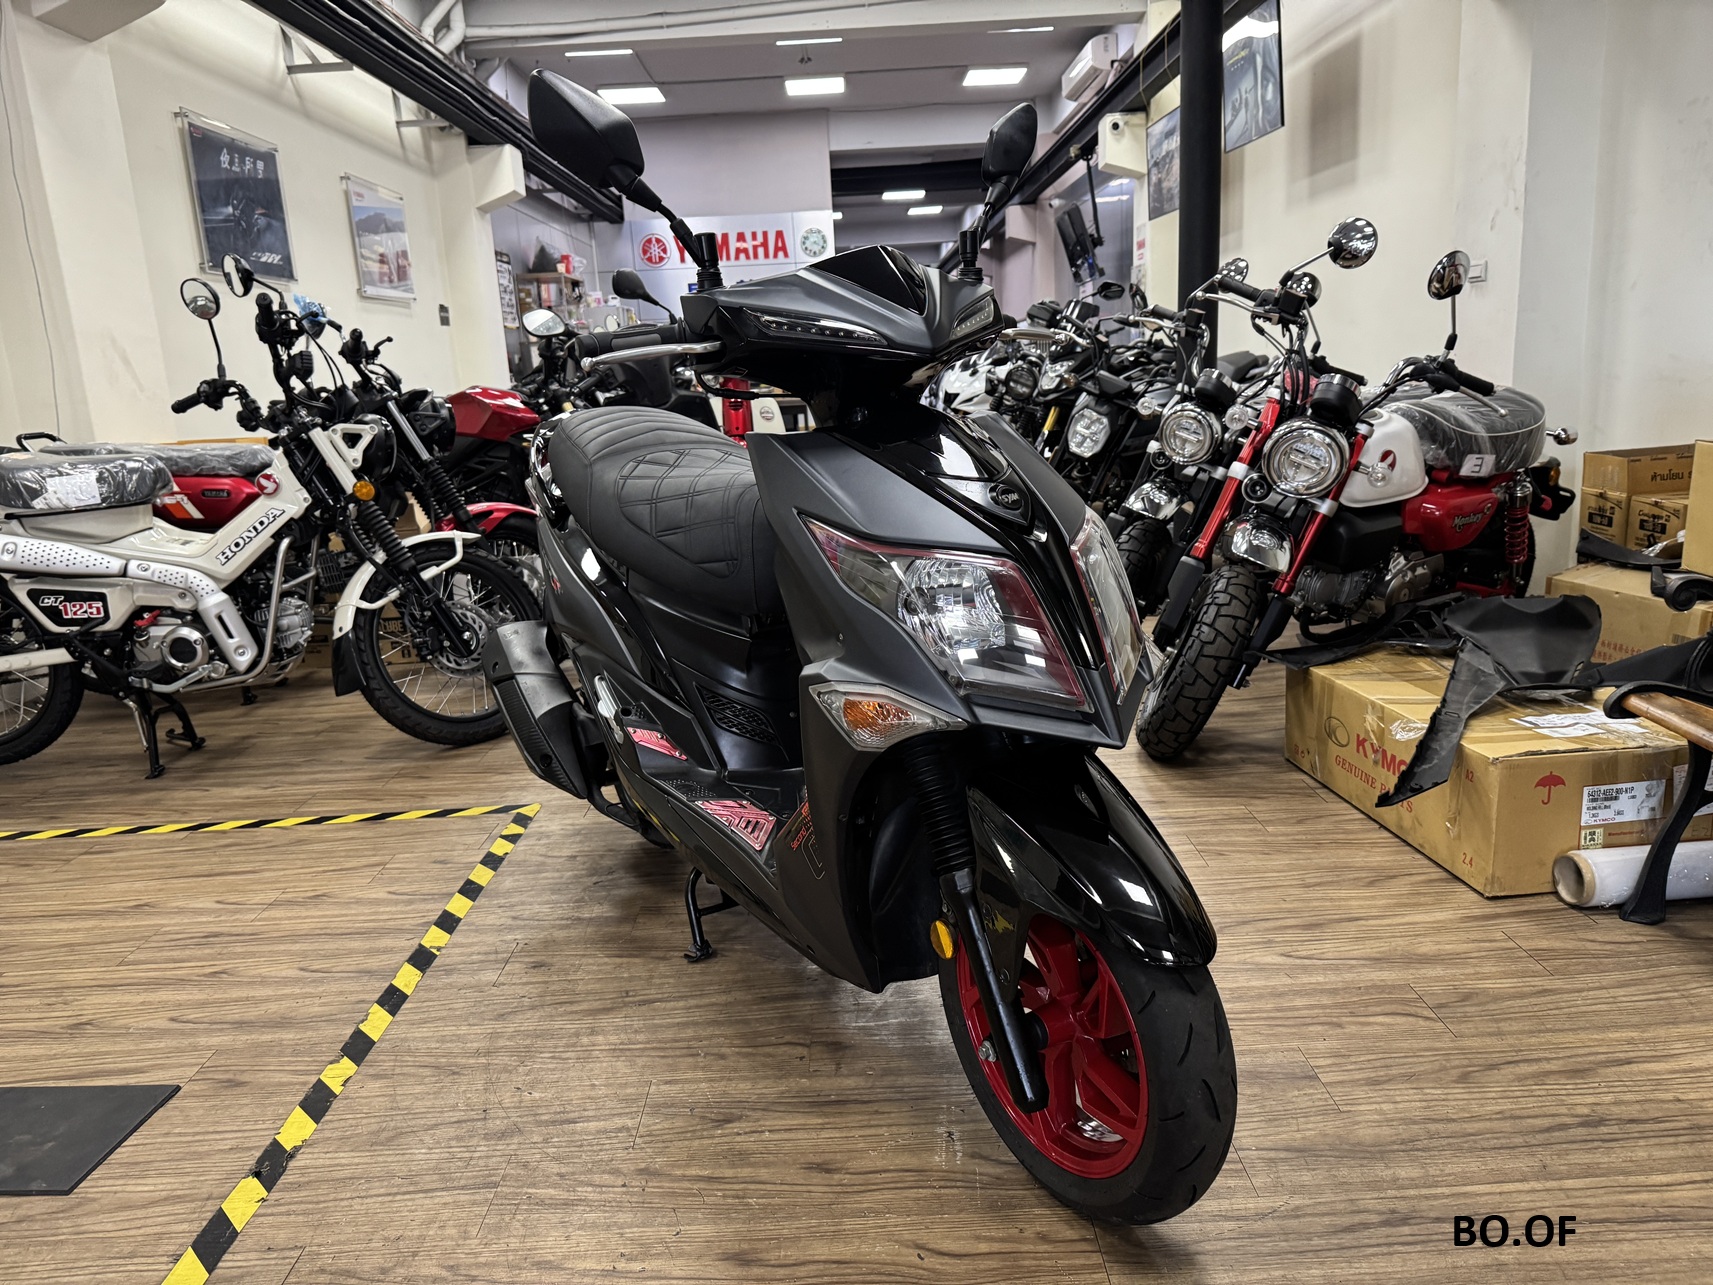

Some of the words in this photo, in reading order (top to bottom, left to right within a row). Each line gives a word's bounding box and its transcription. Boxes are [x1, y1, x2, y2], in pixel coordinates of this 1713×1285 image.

[673, 230, 790, 264] YMAHA
[1001, 492, 1020, 504] SYM
[1452, 513, 1482, 531] Monkey
[214, 507, 286, 567] HONDA
[39, 596, 64, 607] CT
[59, 601, 104, 619] 125
[1356, 733, 1408, 777] KYMC
[1334, 754, 1377, 790] GENUINE
[1465, 768, 1475, 783] A2
[1593, 816, 1616, 824] KYMCO
[1462, 852, 1474, 867] 2.4
